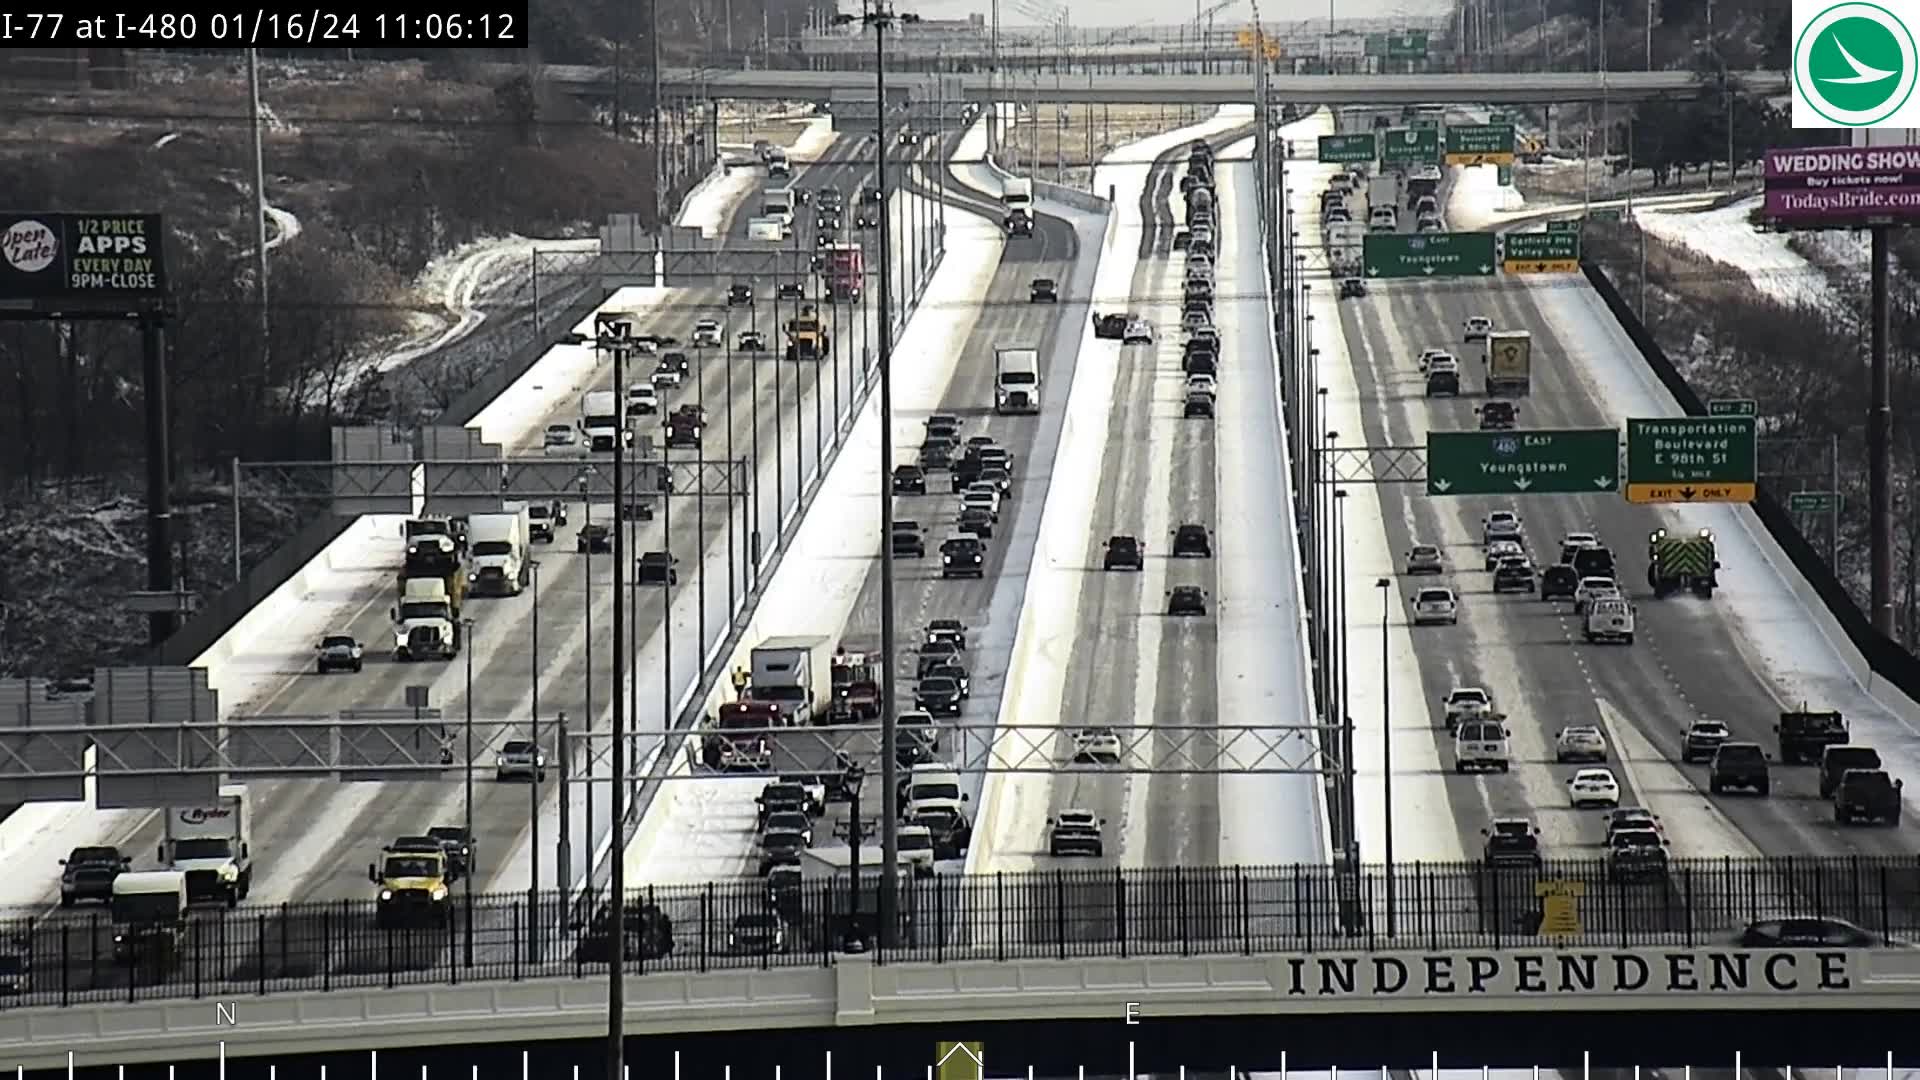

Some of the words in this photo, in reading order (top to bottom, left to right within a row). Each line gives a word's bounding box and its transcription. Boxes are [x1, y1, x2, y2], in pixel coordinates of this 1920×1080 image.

[1773, 154, 1863, 173] WEDDING
[1867, 151, 1920, 170] SHOW
[1807, 177, 1829, 187] Buy
[1832, 175, 1870, 185] tickets
[1874, 174, 1903, 184] now!
[78, 219, 99, 235] 1/2
[102, 219, 145, 235] PRICE
[0, 228, 46, 249] Open
[78, 236, 147, 254] APPS
[12, 239, 60, 264] Late!
[1511, 247, 1542, 257] Valley
[1549, 247, 1572, 256] View
[74, 258, 119, 272] EVERY
[123, 257, 153, 272] DAY
[1399, 254, 1460, 265] Youngstown
[72, 273, 156, 289] 9PM-CLOSE
[1739, 403, 1753, 413] 21
[1637, 423, 1746, 436] Transportation
[1655, 438, 1729, 450] Boulevard
[1655, 453, 1664, 464] E
[1671, 453, 1705, 464] 98th
[1712, 453, 1727, 464] St
[1480, 461, 1568, 476] Youngstown
[1650, 489, 1672, 498] EXIT
[1703, 489, 1731, 498] ONLY
[1288, 953, 1850, 994] INDEPENDENCE
